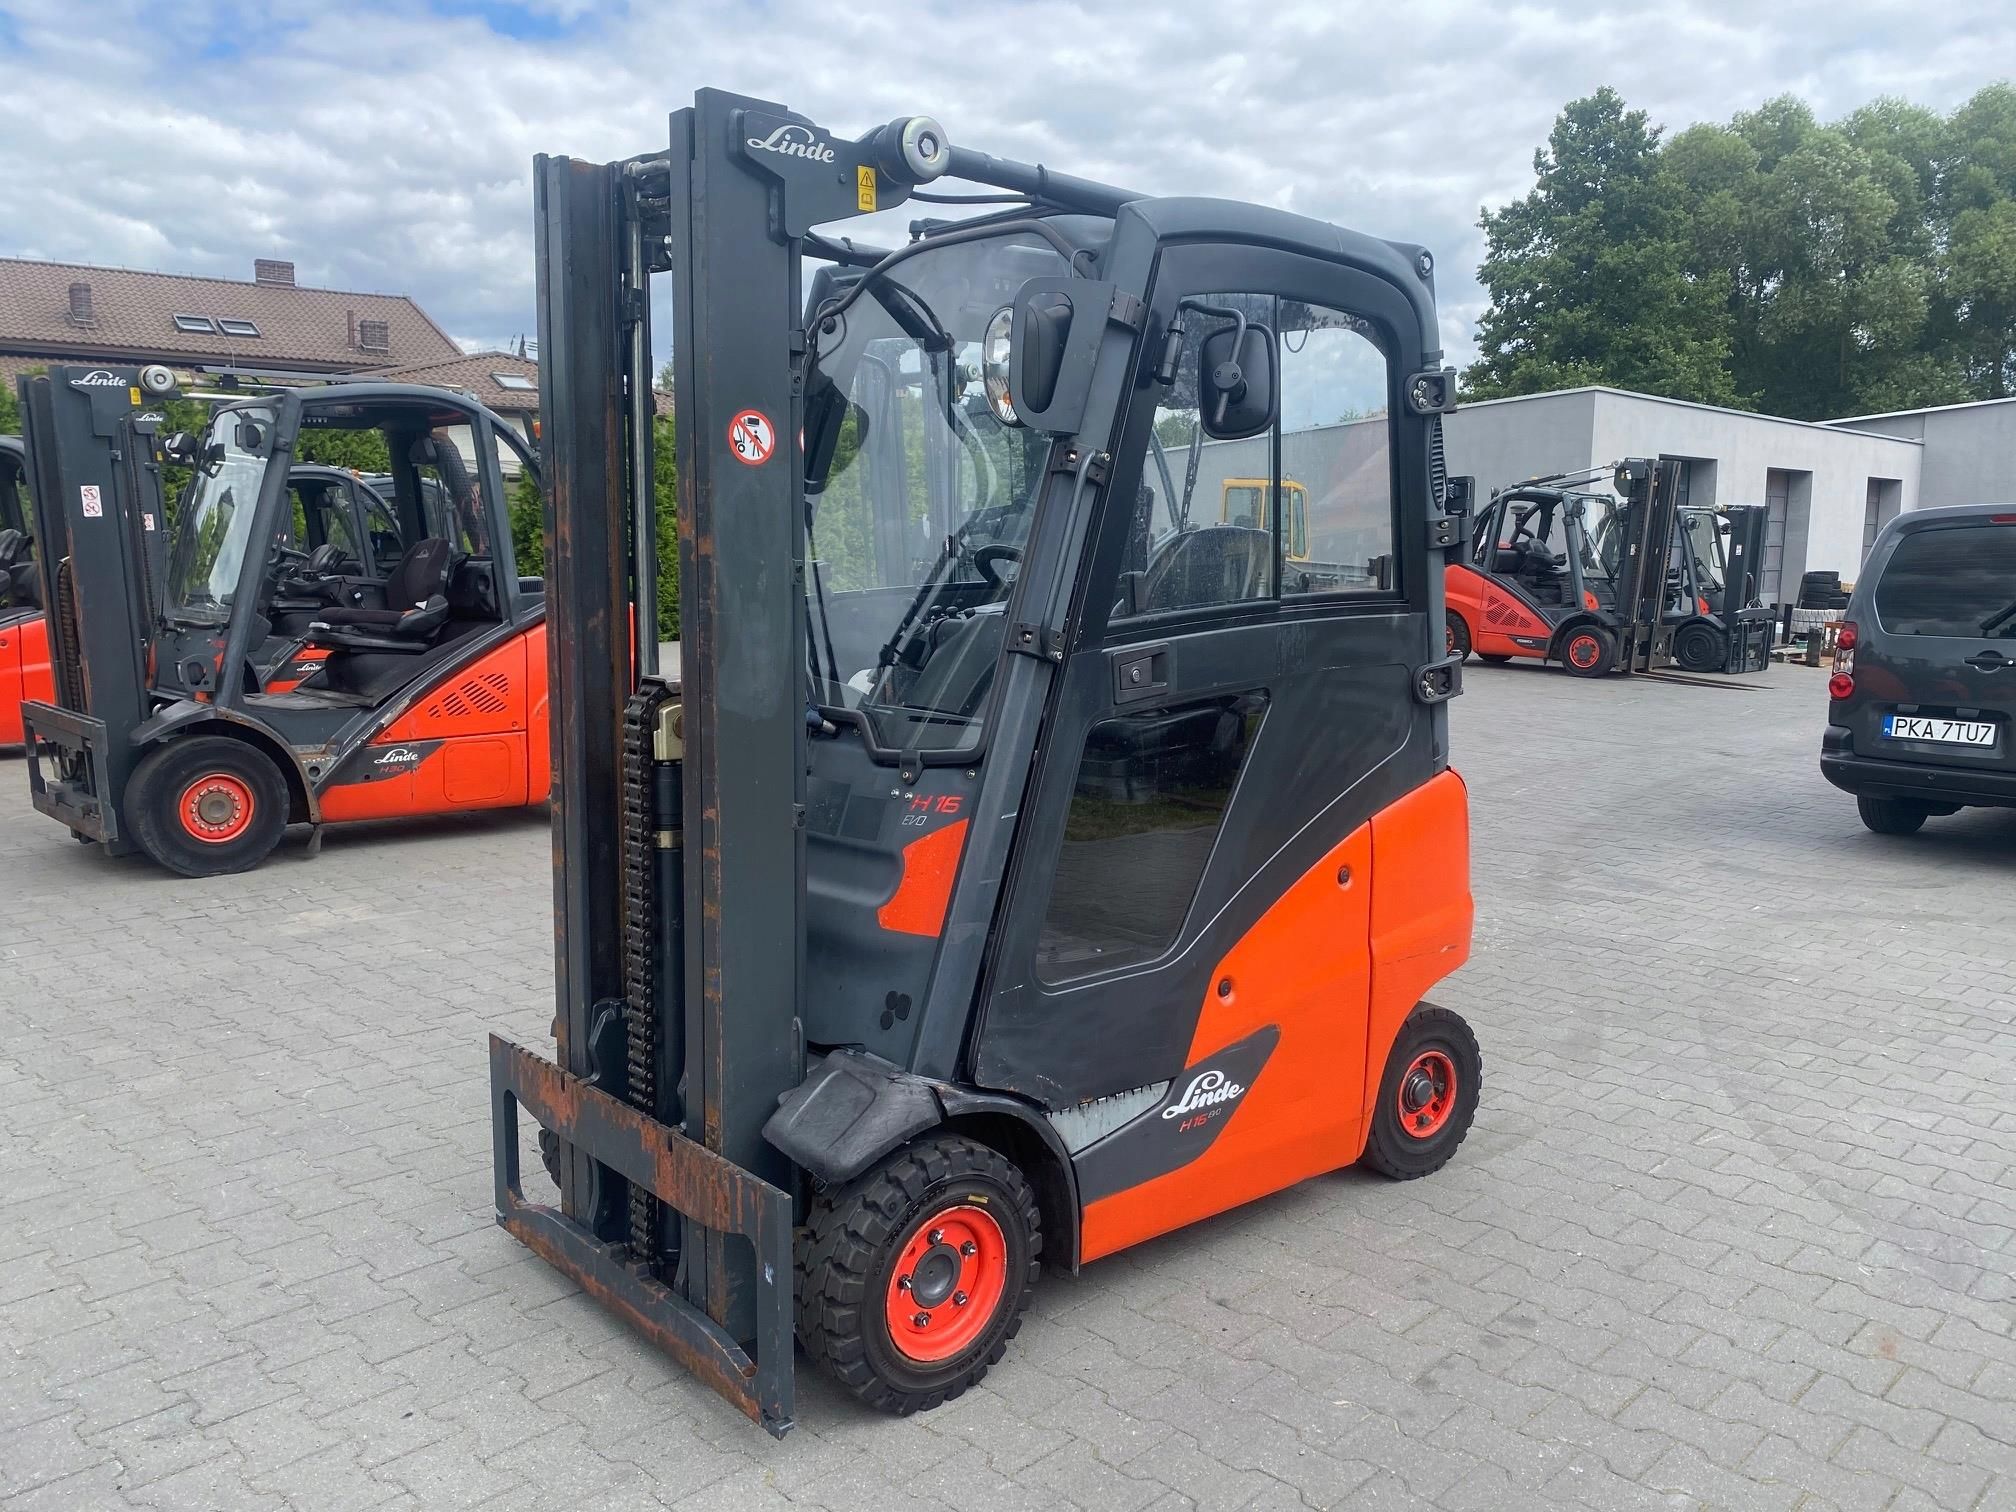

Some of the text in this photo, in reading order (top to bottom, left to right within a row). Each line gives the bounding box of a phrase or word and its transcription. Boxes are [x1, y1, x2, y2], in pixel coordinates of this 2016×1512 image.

[746, 125, 835, 163] Linde
[70, 370, 127, 387] Linde
[135, 412, 164, 422] Linde
[1894, 718, 1993, 743] PKA 7TU7
[373, 748, 419, 764] Linde
[1162, 1070, 1245, 1119] Linde
